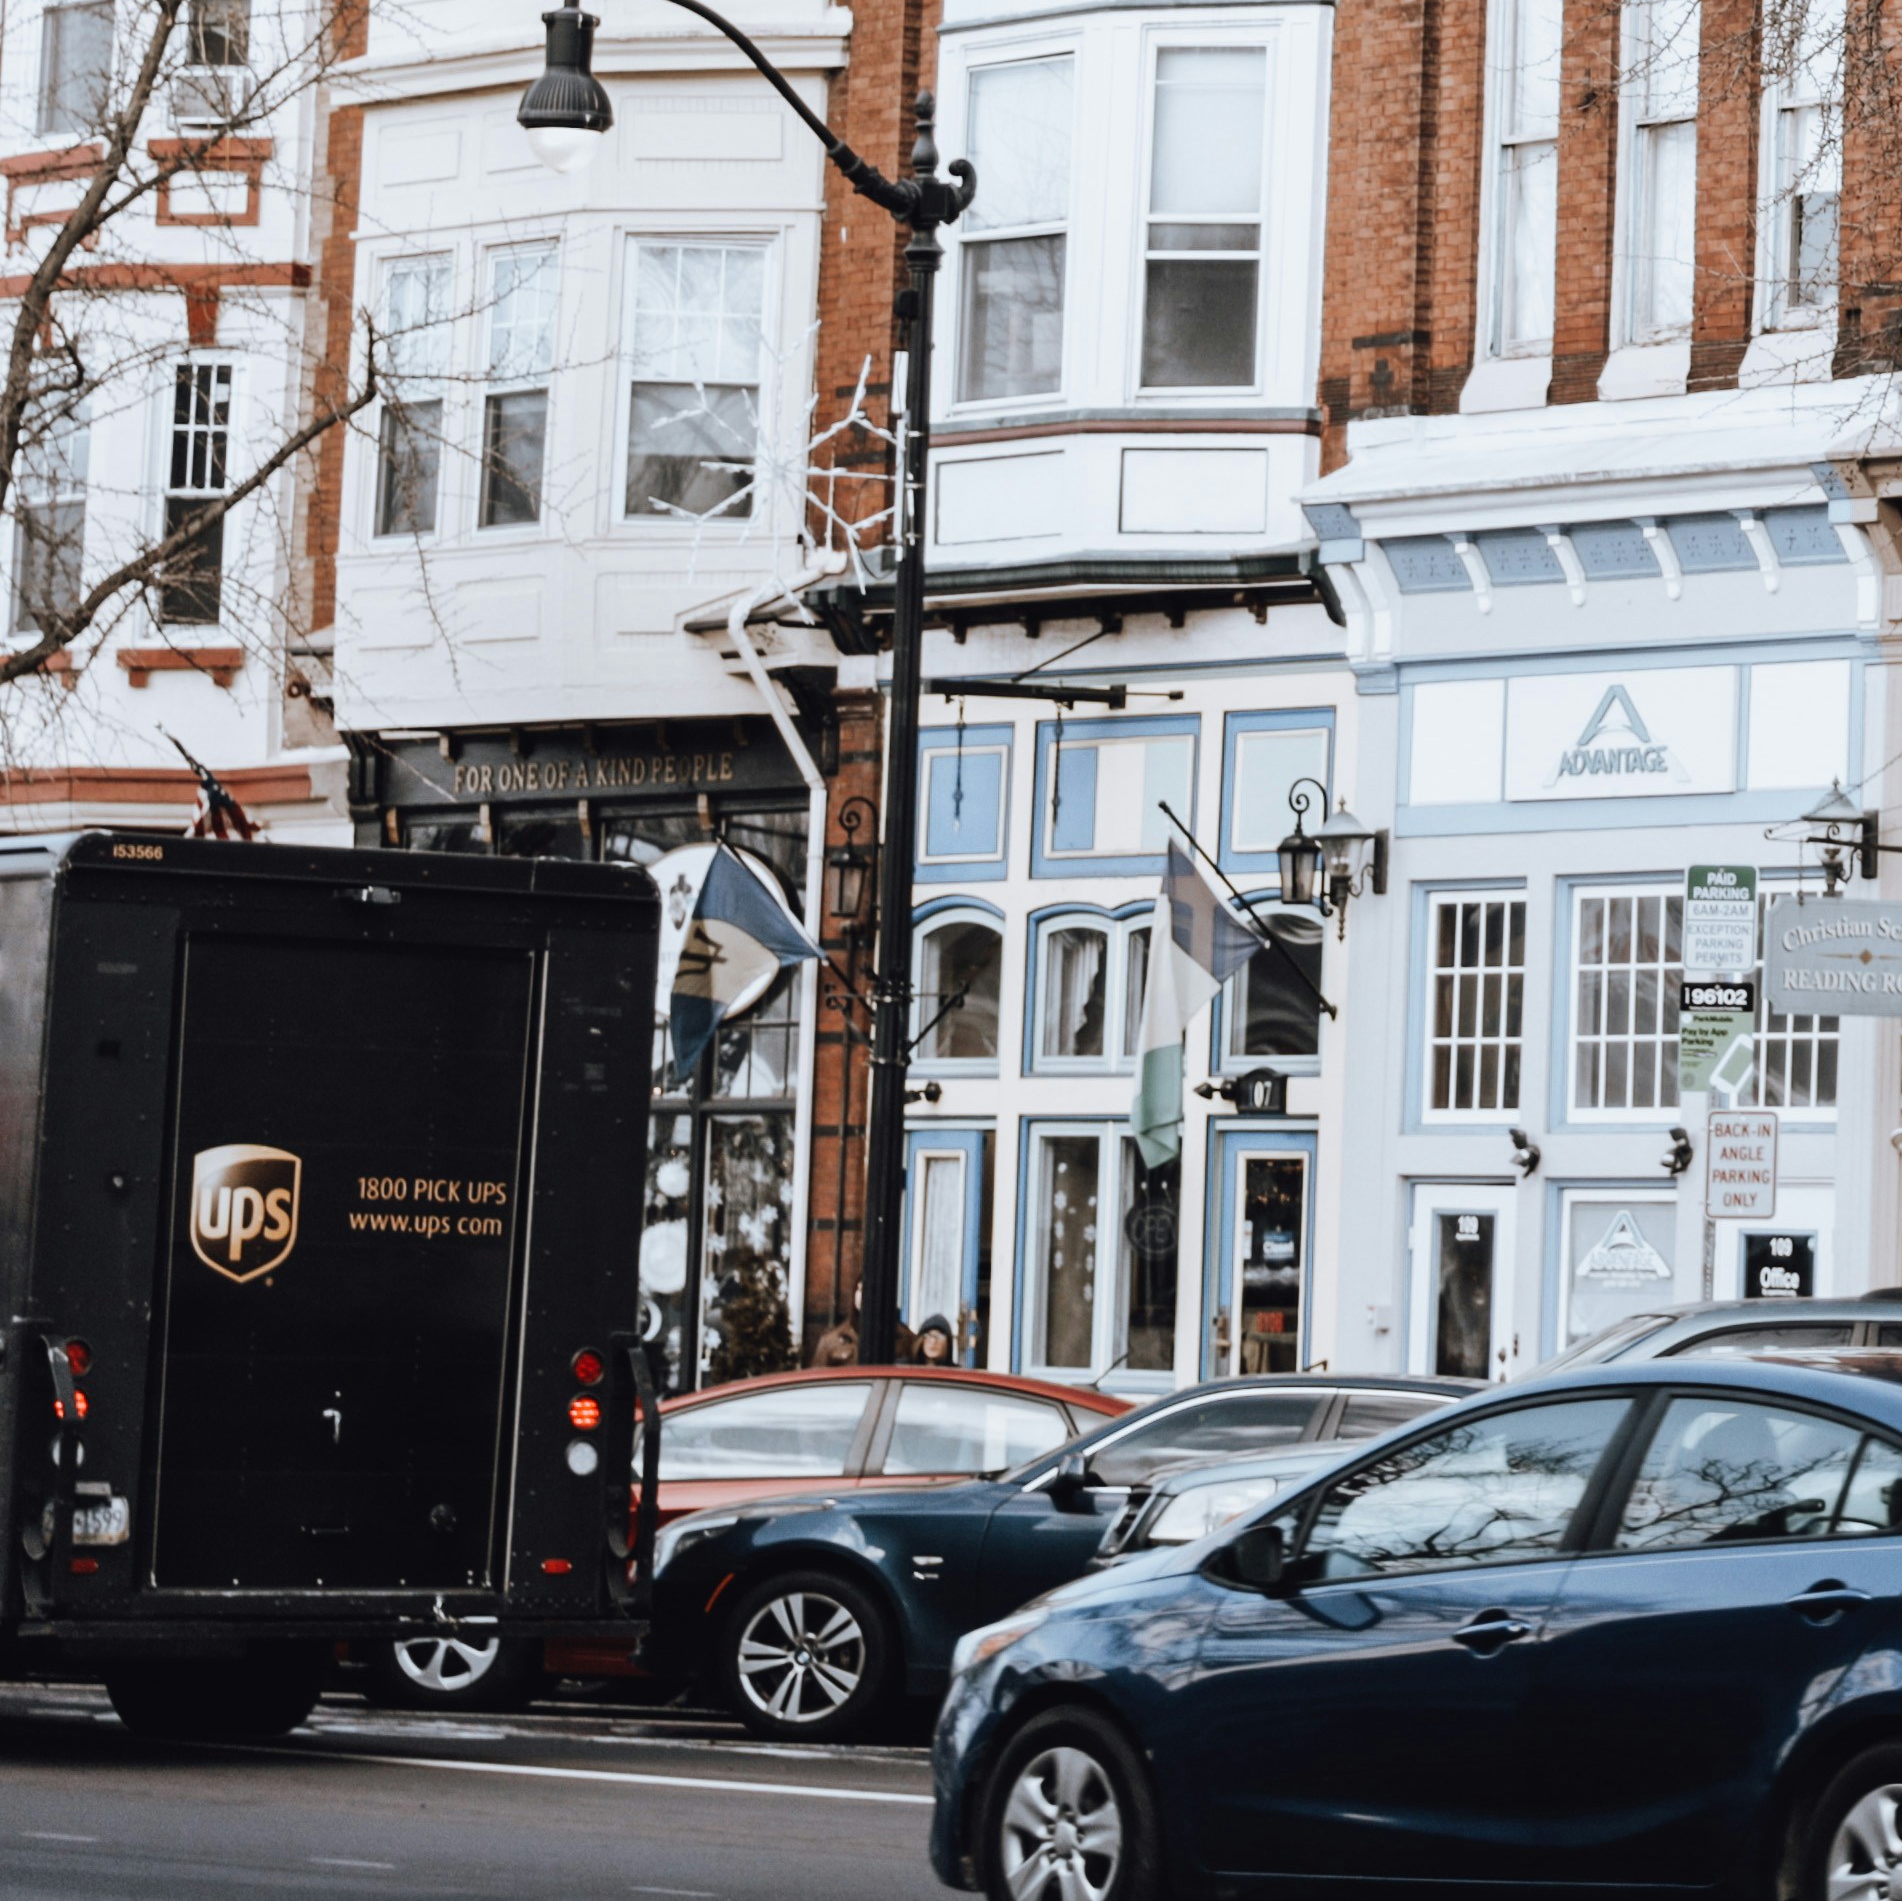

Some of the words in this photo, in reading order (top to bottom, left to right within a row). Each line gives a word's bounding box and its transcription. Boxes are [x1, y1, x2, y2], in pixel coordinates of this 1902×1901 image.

[1558, 746, 1669, 777] ADVANTAGE
[454, 764, 493, 793] FOR
[500, 761, 539, 791] ONE
[543, 760, 571, 790] OF
[575, 759, 589, 788] A
[596, 756, 645, 786] KIND
[651, 752, 733, 783] PEOPLE
[1706, 872, 1737, 886] PAID
[1692, 886, 1750, 900] PARKING
[1782, 914, 1872, 952] Christian
[1695, 939, 1744, 950] PARKING
[1695, 952, 1743, 963] PERMITS
[1783, 968, 1876, 994] READING
[1714, 1123, 1771, 1138] BACK-IN
[1720, 1146, 1764, 1161] ANGLE
[1712, 1169, 1770, 1185] PARKING
[358, 1178, 407, 1201] 1800
[414, 1179, 461, 1203] PICK
[468, 1182, 507, 1205] UPS
[1723, 1192, 1758, 1208] ONLY
[200, 1186, 293, 1261] ups
[1760, 1266, 1801, 1290] Office
